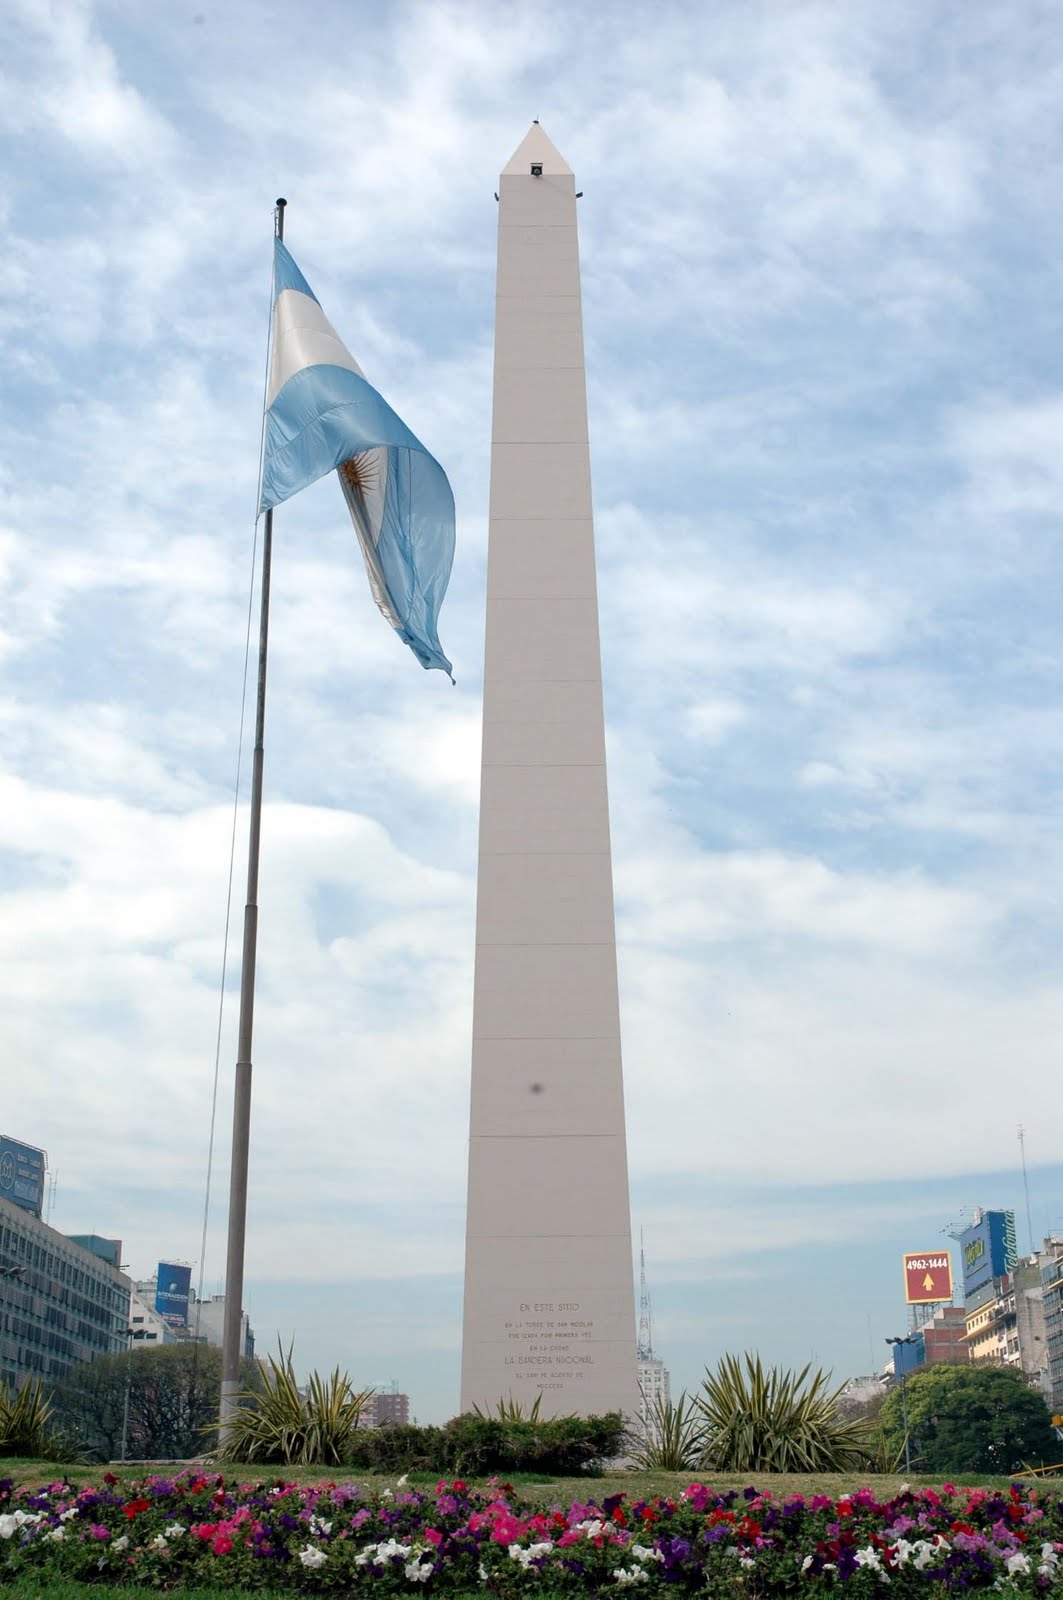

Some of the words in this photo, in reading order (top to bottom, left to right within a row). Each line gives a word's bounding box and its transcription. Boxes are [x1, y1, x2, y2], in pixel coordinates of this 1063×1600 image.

[907, 1258, 948, 1270] 4962-1444
[519, 1303, 530, 1312] EN
[534, 1303, 554, 1312] ESTE
[558, 1303, 580, 1312] SITIO
[504, 1356, 514, 1365] LA
[518, 1355, 553, 1365] BANDERA
[555, 1355, 594, 1365] NACIONAL
